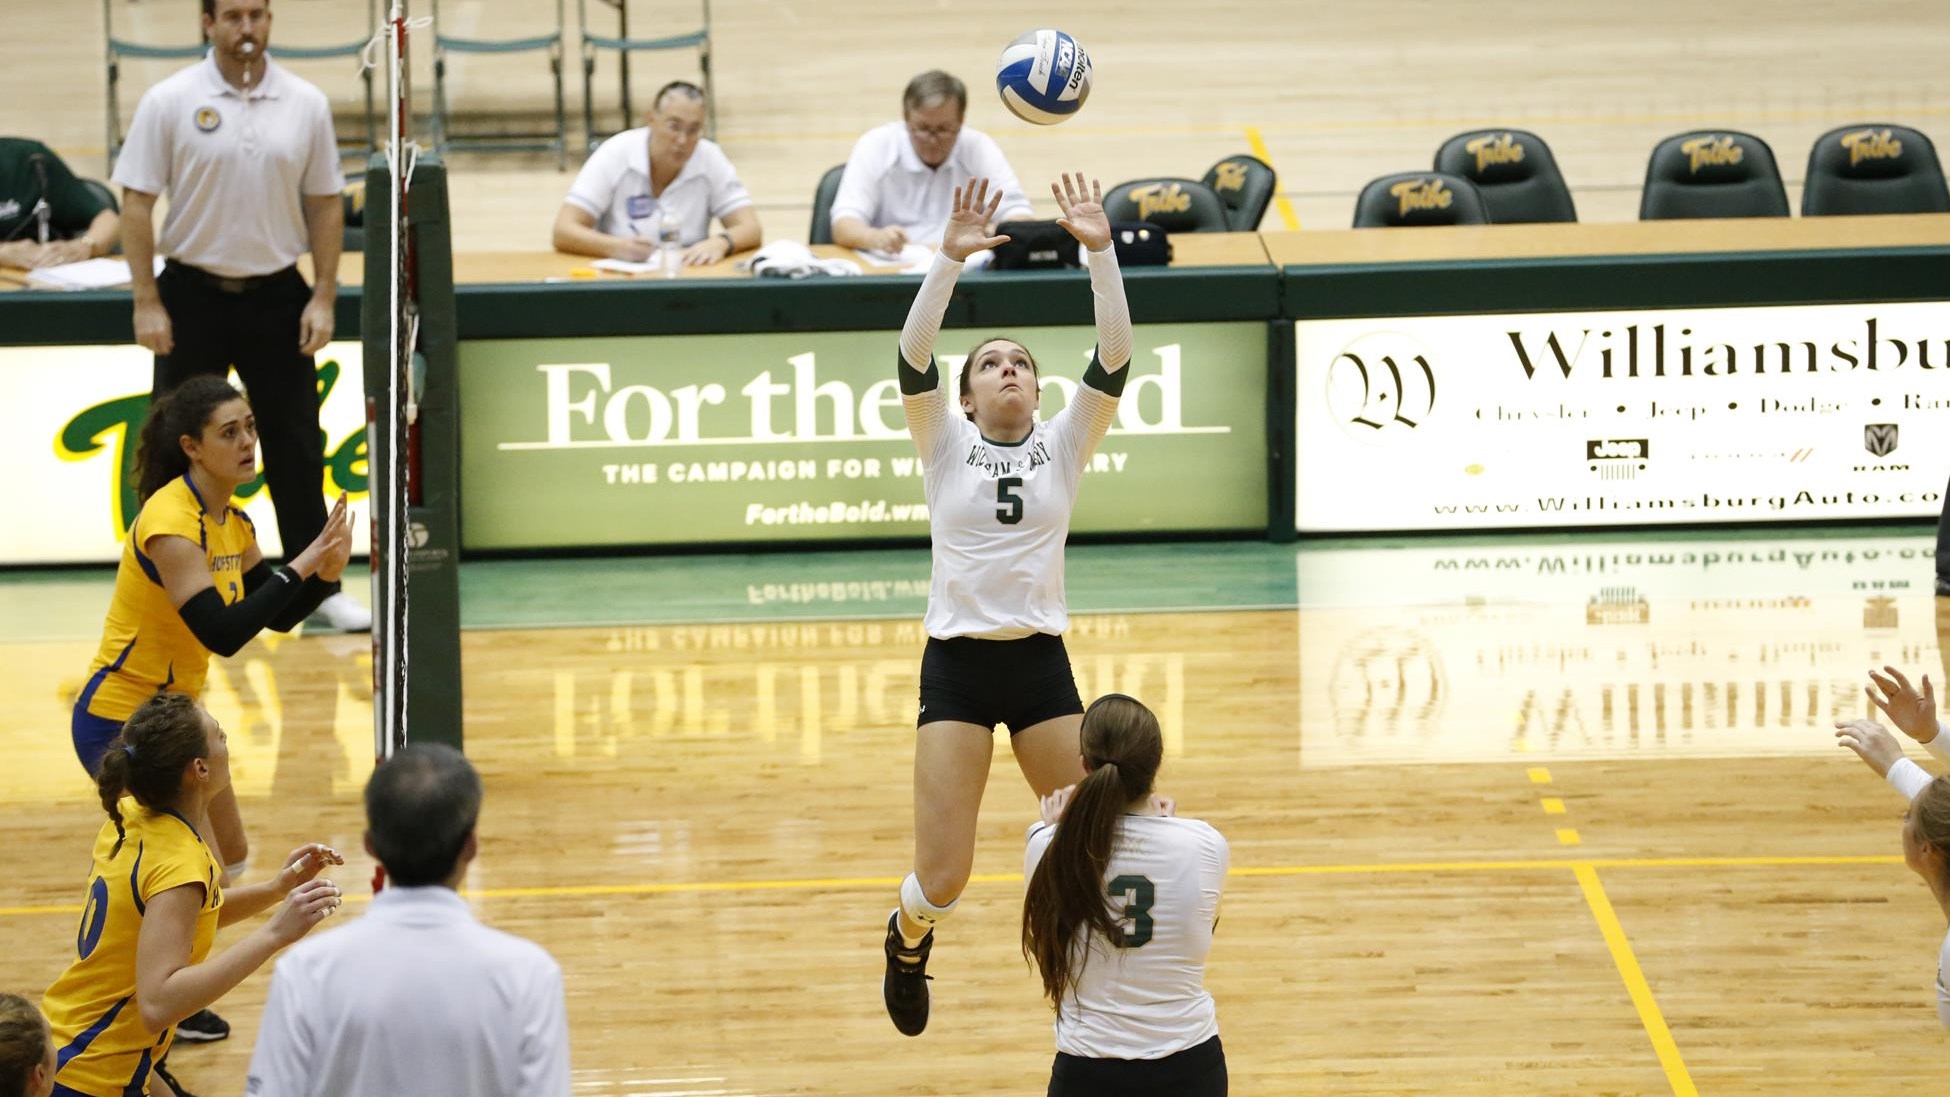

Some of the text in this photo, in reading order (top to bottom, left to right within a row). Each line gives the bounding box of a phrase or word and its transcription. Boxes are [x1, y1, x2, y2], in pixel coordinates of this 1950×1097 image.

[1465, 133, 1526, 174] Tribe
[1681, 136, 1744, 174] Tribe
[1840, 129, 1903, 167] Tribe
[1128, 183, 1193, 221] Tribe
[1390, 178, 1453, 218] Tribe
[536, 362, 726, 444] For
[741, 351, 913, 440] the
[1593, 440, 1641, 459] Jeep
[601, 464, 657, 484] THE
[668, 459, 817, 483] CAMPAIGN
[826, 458, 880, 478] FOR
[996, 477, 1023, 525] 5
[1106, 874, 1155, 949] 3
